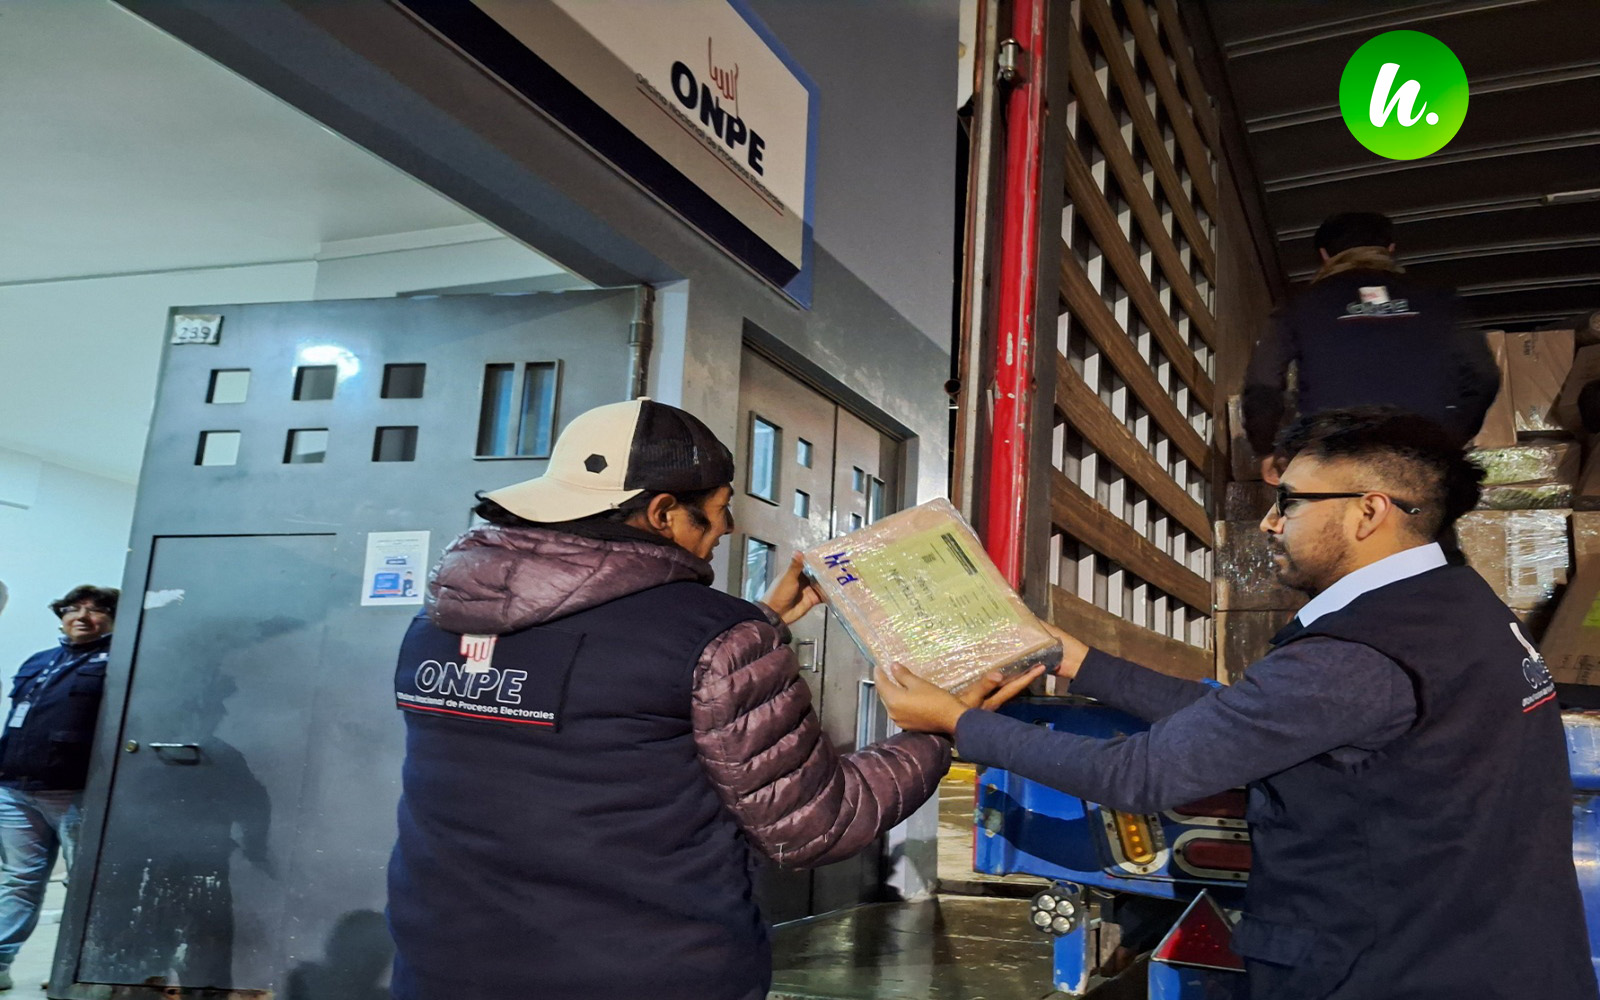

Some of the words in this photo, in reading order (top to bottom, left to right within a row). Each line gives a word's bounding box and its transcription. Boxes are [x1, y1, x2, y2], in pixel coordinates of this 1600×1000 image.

[671, 61, 765, 176] ONPE
[706, 136, 717, 150] de
[178, 326, 211, 340] 239
[415, 659, 528, 705] ONPE
[446, 698, 458, 708] de
[458, 700, 499, 714] Procesos
[500, 706, 555, 720] Electorales
